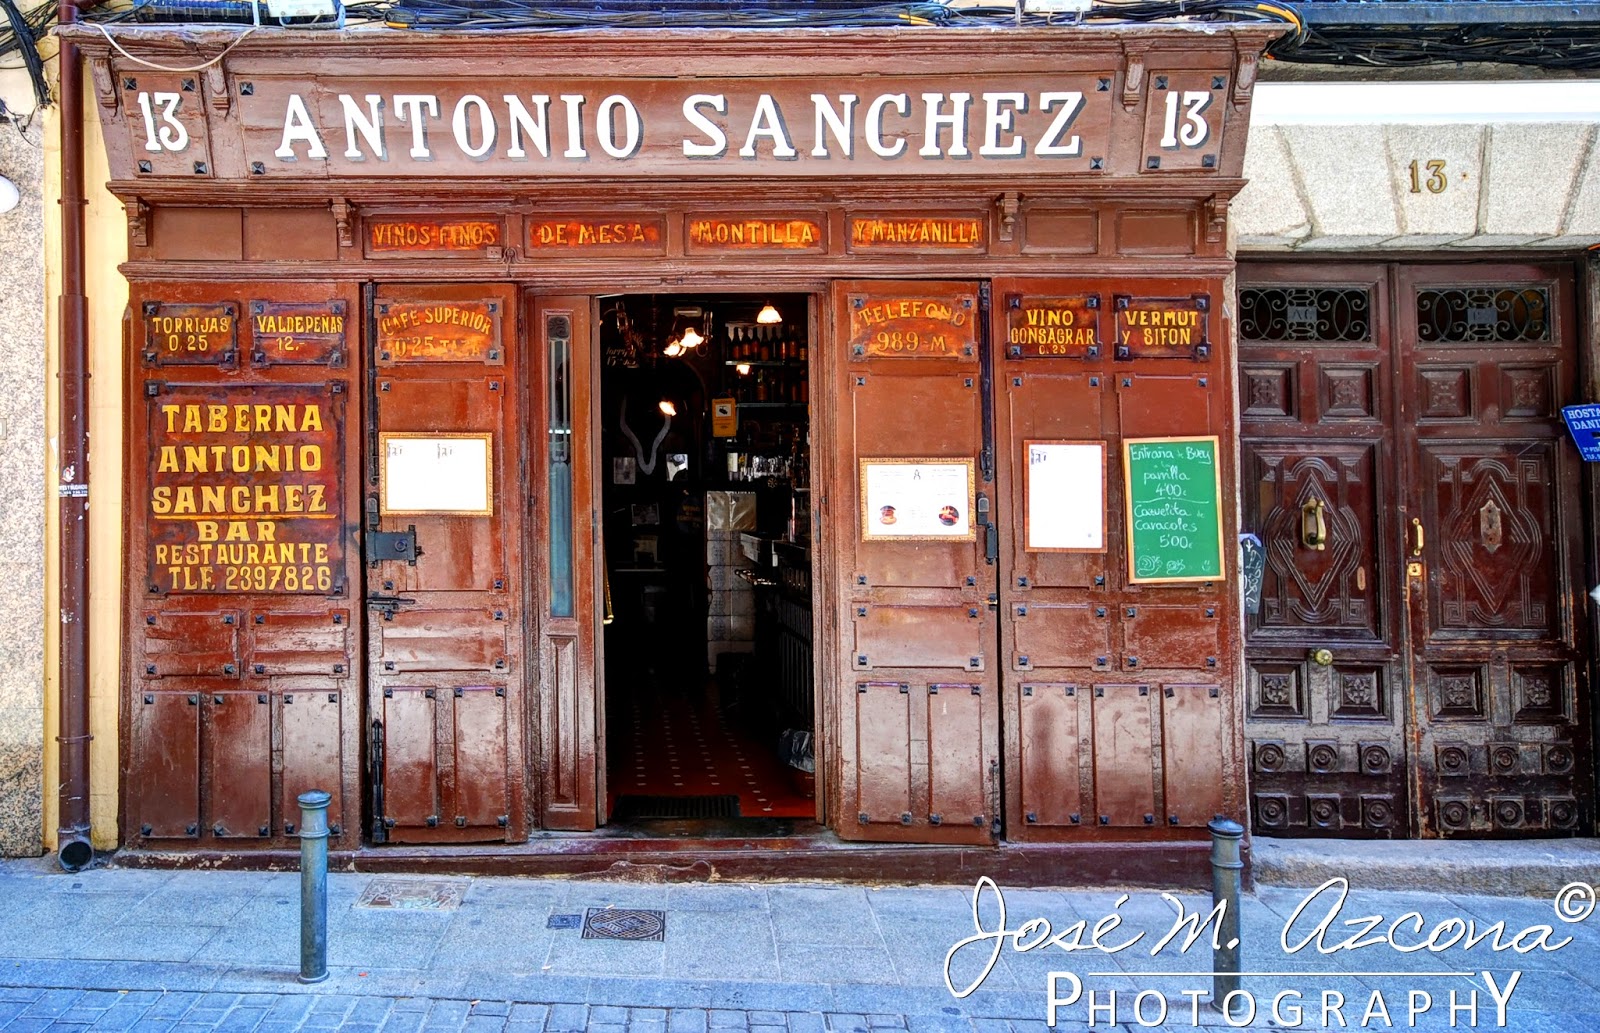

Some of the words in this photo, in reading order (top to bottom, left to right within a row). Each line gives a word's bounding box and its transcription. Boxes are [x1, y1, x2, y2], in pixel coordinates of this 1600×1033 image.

[137, 91, 190, 152] 13
[274, 93, 645, 161] ANTONIO
[681, 91, 1086, 160] SANCHEZ
[1160, 90, 1210, 149] 13
[1408, 159, 1448, 194] 13
[374, 225, 430, 246] VINOS
[540, 224, 568, 244] DE
[578, 224, 645, 244] MESA
[698, 221, 814, 244] MONTILLA
[152, 317, 230, 334] TORRIJAS
[256, 314, 344, 334] VALDEPEÑAS
[424, 306, 492, 335] SUPERIOR
[858, 301, 966, 327] TELEFONO
[1026, 309, 1075, 327] VINO
[1124, 310, 1199, 327] VERMUT
[1143, 328, 1192, 346] SIFON
[161, 404, 324, 433] TABERNA
[157, 444, 323, 473] ANTONIO
[151, 484, 328, 514] SANCHEZ
[196, 521, 277, 542] BAR
[1134, 517, 1198, 533] Caracoles
[155, 543, 329, 565] RESTAURANTE
[225, 566, 332, 591] 2397826
